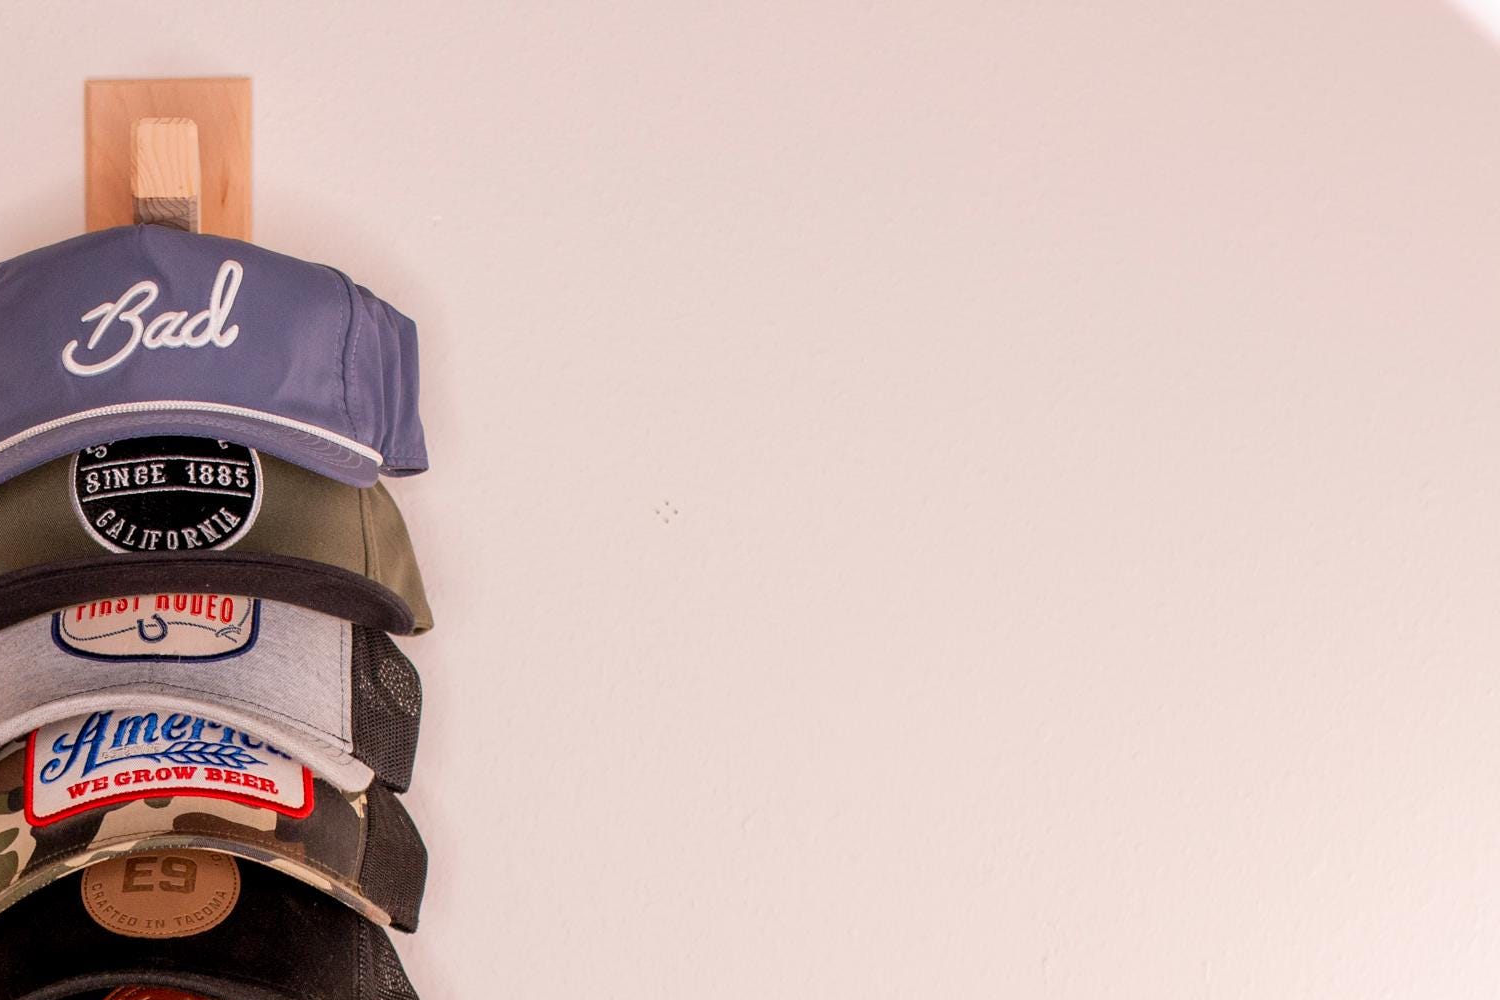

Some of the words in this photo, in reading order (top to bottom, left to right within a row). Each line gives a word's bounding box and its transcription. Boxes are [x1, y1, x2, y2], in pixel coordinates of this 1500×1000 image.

[62, 259, 244, 376] Bad
[85, 463, 166, 494] SINCE
[185, 462, 249, 488] 1885
[96, 507, 242, 550] CALIFORNIA
[155, 595, 235, 624] RODEO
[40, 709, 293, 785] Americ
[67, 775, 109, 800] WE
[114, 766, 196, 787] GROW
[204, 766, 279, 796] BEER
[122, 856, 198, 894] E9
[91, 882, 138, 927] CRAFTED
[146, 919, 165, 929] IN
[172, 889, 228, 927] TACOMA
